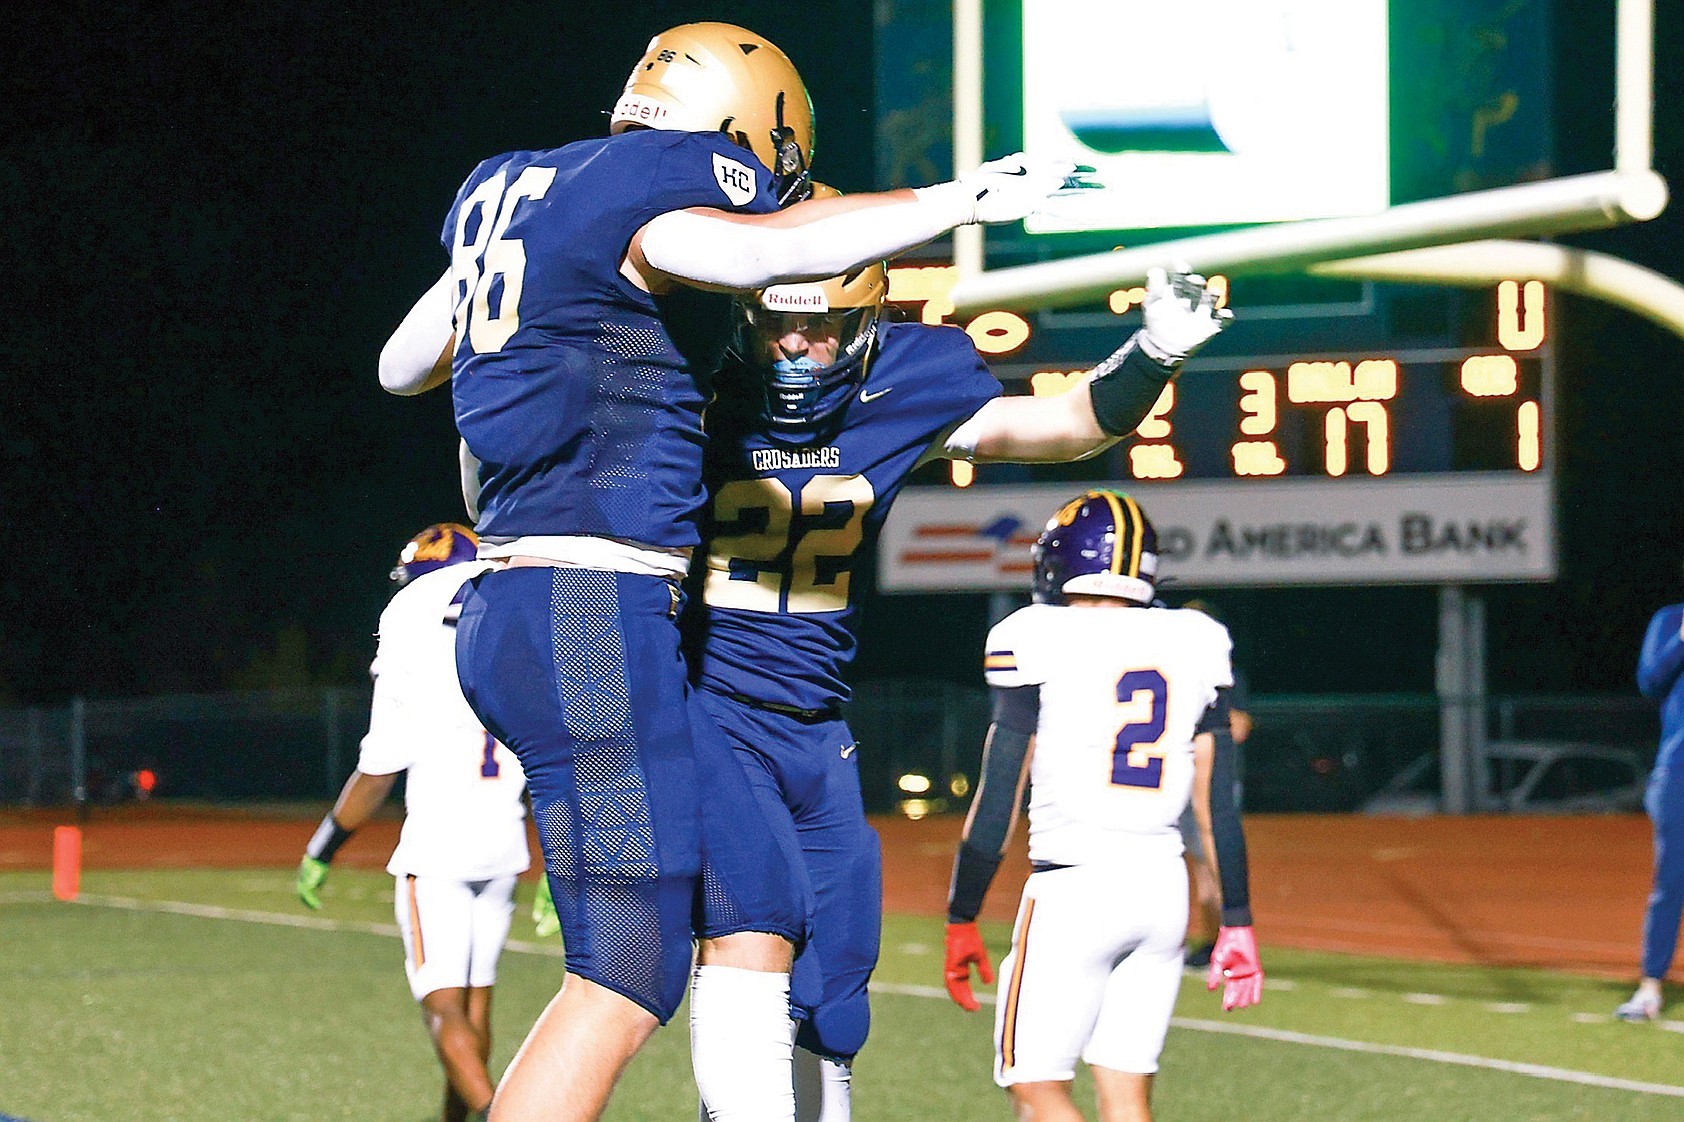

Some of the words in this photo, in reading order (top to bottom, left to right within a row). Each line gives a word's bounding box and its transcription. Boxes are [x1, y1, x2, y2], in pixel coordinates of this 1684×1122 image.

[721, 165, 750, 193] HC
[452, 166, 558, 358] 86
[768, 293, 822, 306] Riddell
[752, 447, 840, 471] CRUSADERS
[703, 474, 875, 614] 22
[1204, 515, 1388, 558] AMERICA
[1400, 511, 1529, 555] BANK
[1110, 668, 1169, 791] 2
